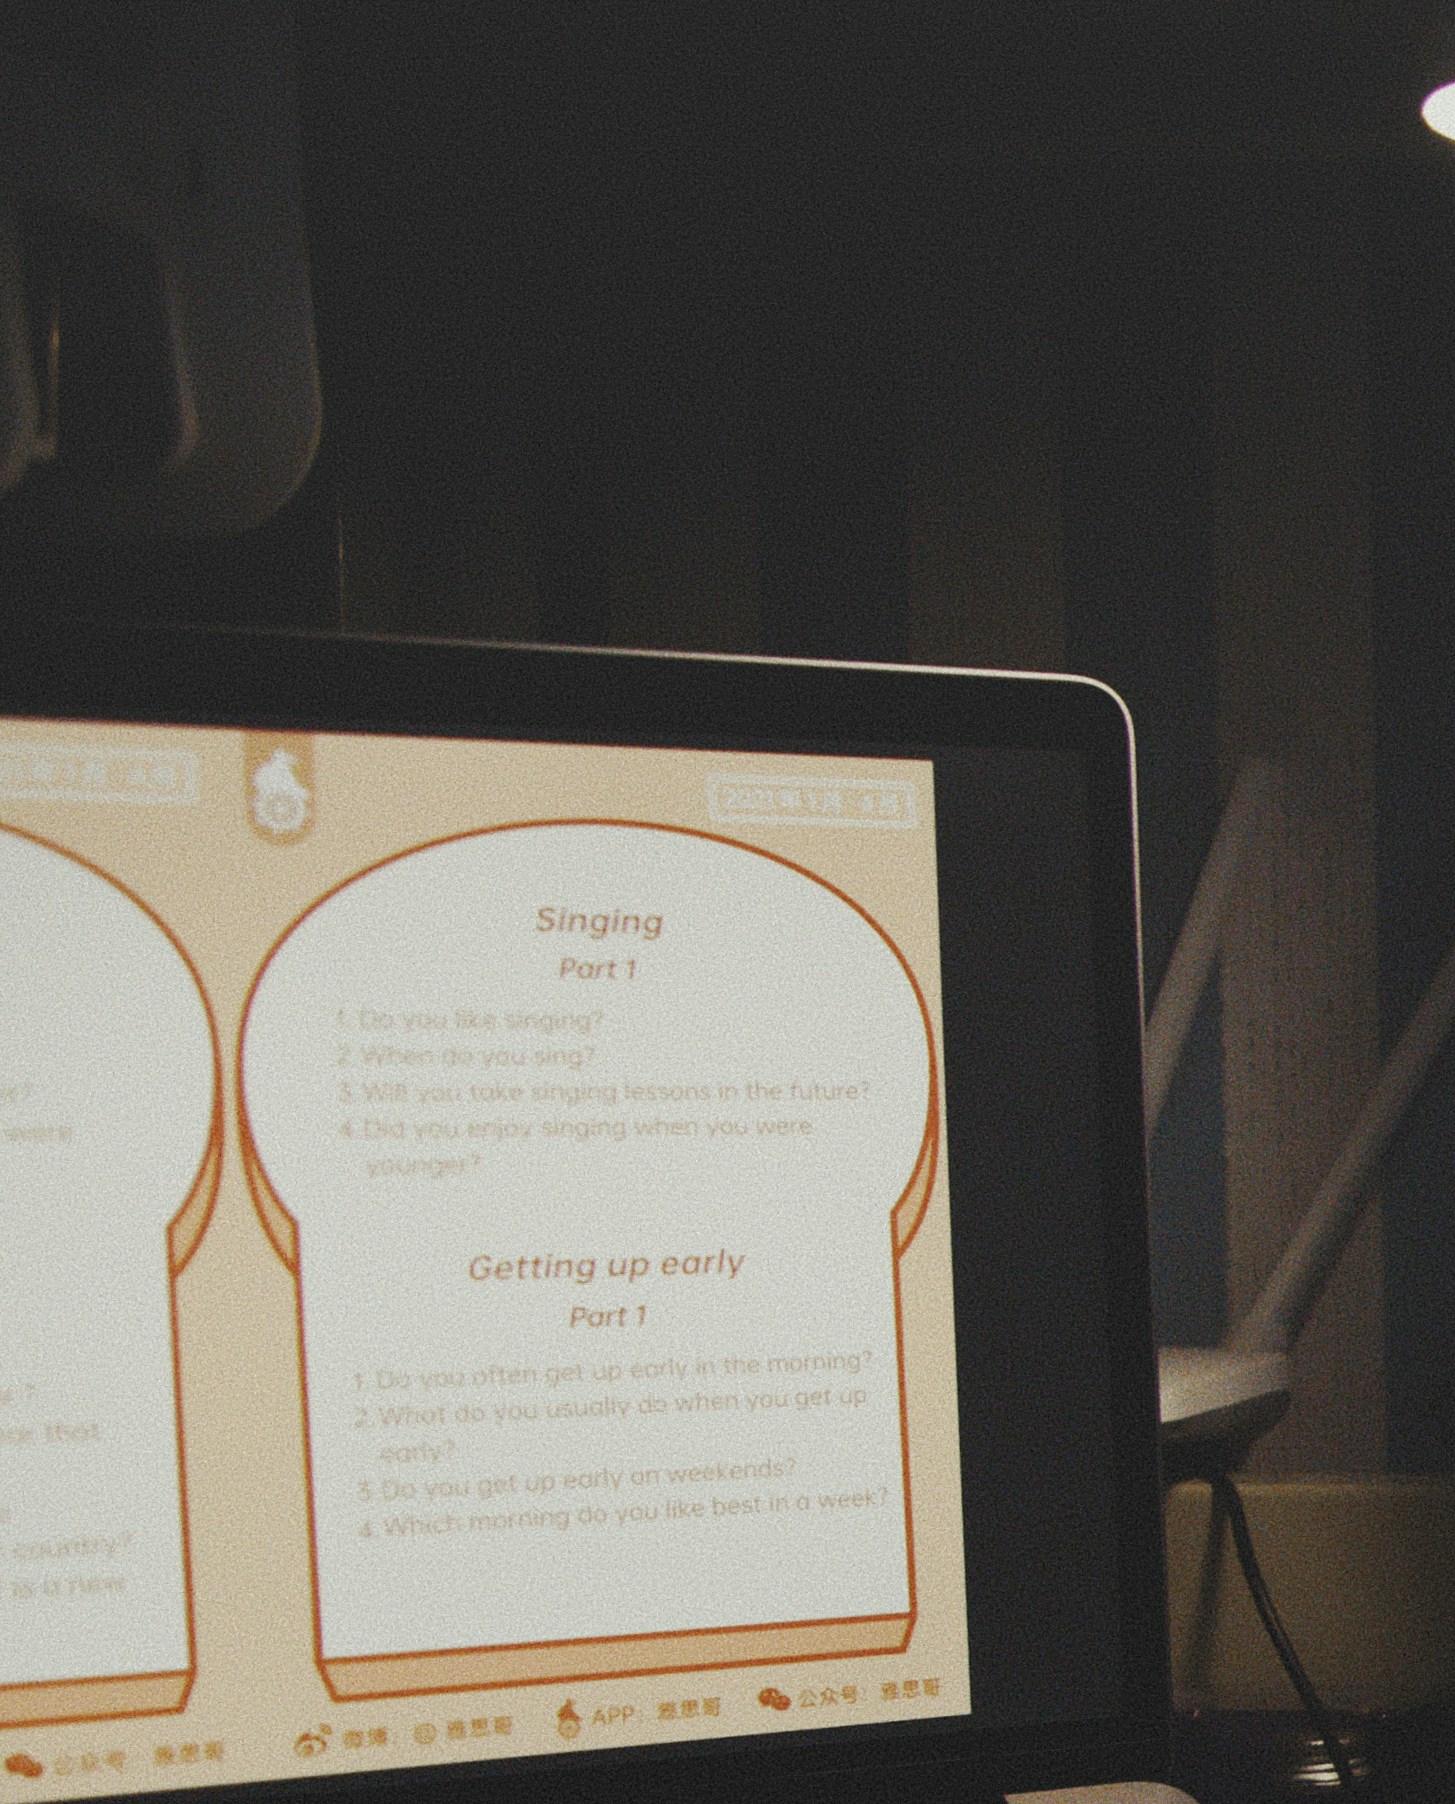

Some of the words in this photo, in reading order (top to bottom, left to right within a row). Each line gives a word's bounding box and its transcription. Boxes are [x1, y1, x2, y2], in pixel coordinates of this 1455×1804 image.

[535, 905, 664, 941] Singing
[559, 957, 617, 979] Part
[625, 956, 637, 979] 1
[468, 1253, 597, 1286] Getting
[607, 1255, 651, 1285] up
[659, 1247, 746, 1280] early
[569, 1304, 629, 1328] Part
[636, 1303, 648, 1326] 1
